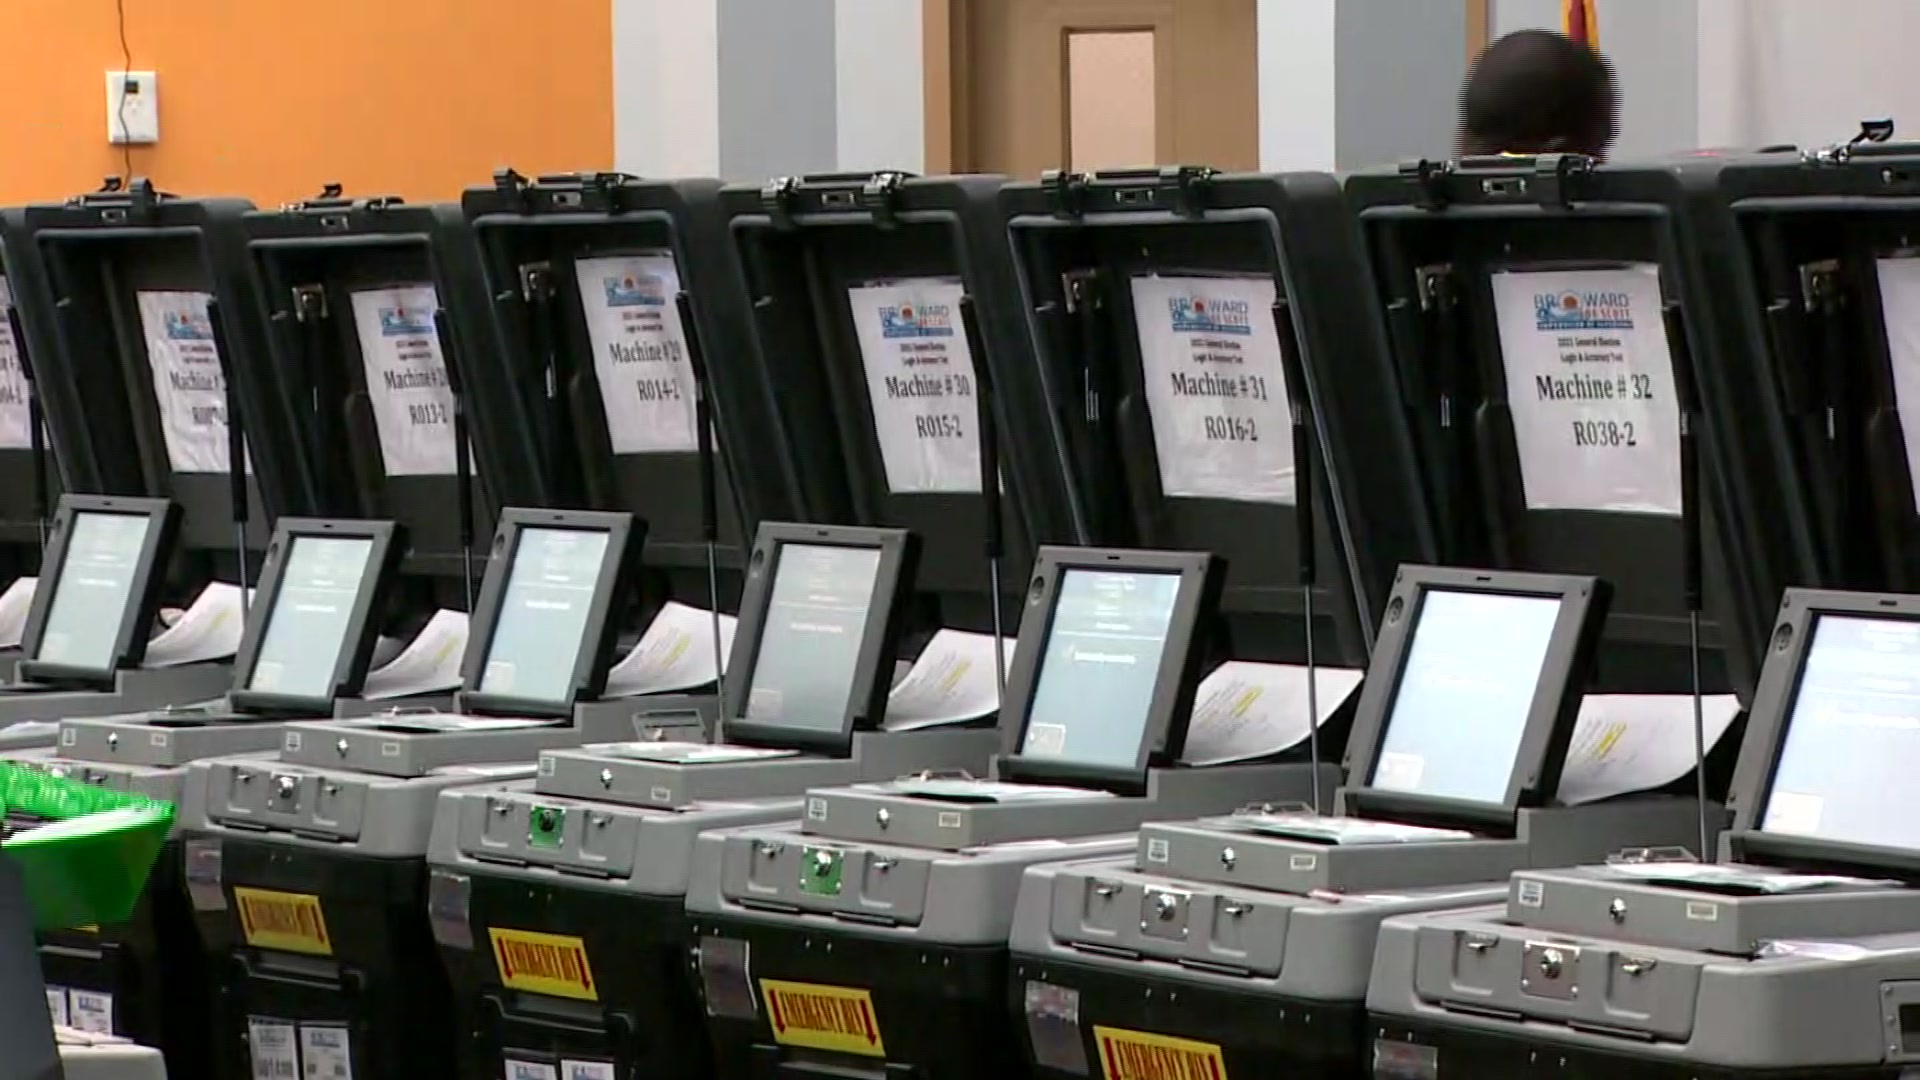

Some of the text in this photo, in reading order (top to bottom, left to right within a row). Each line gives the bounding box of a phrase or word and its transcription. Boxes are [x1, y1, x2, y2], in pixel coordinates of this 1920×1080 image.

[608, 340, 662, 364] Machine
[885, 374, 943, 399] Machine
[954, 373, 970, 397] 30
[1171, 372, 1237, 398] Machine
[1249, 375, 1267, 402] 31
[1536, 373, 1653, 401] Machine # 32
[915, 414, 963, 439] R015-2
[1205, 415, 1258, 442] R016-2
[1572, 421, 1637, 447] R038-2
